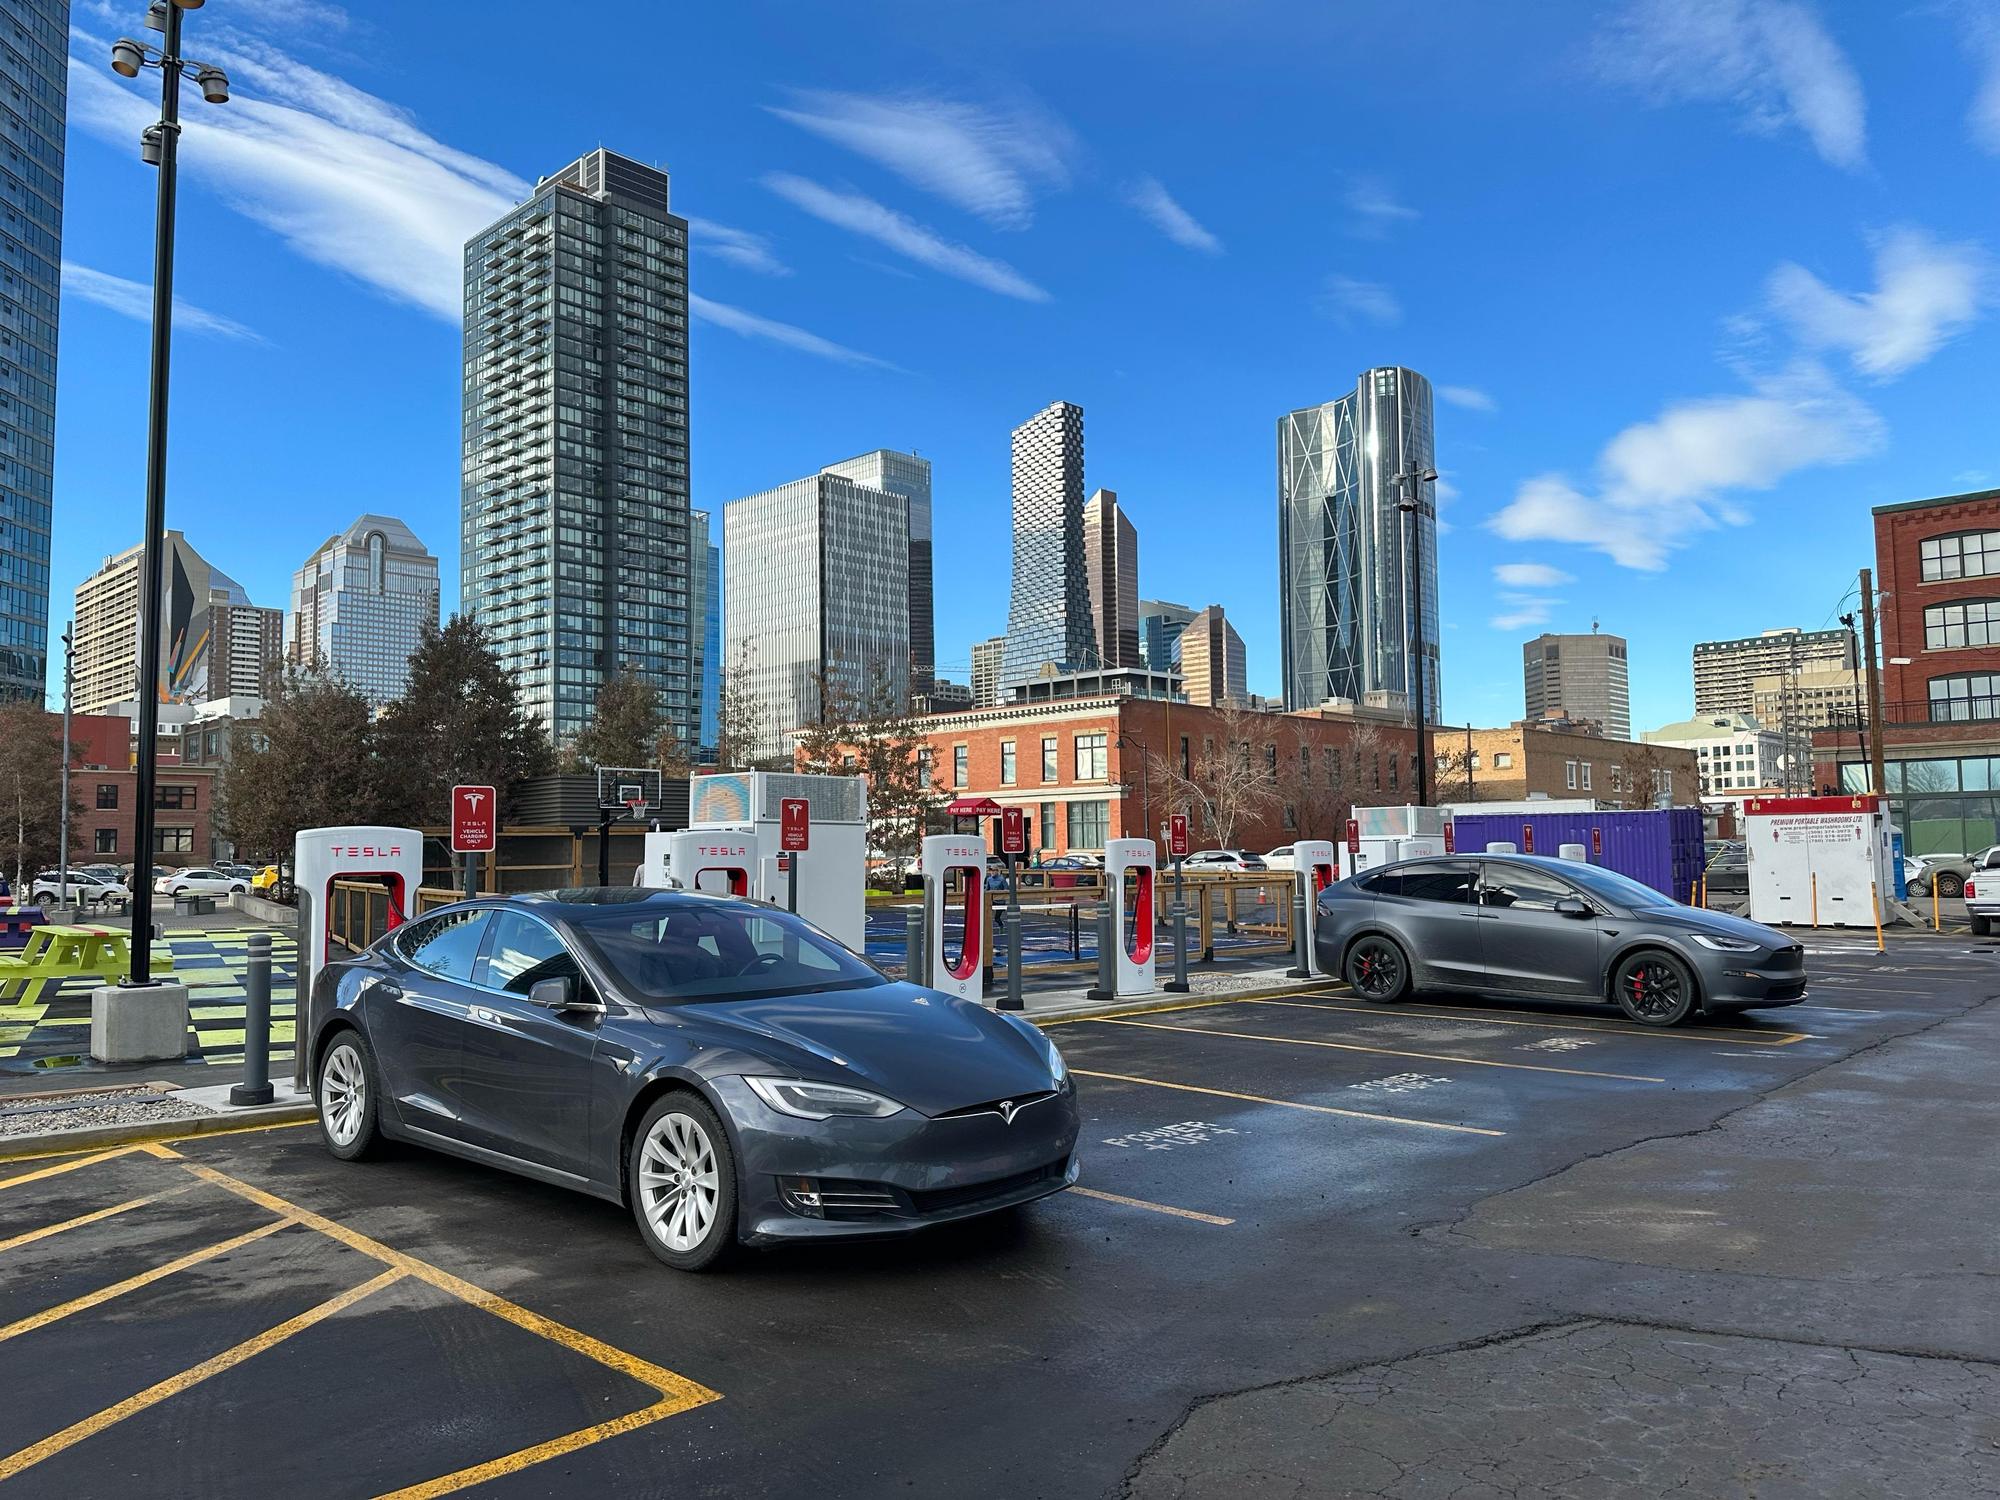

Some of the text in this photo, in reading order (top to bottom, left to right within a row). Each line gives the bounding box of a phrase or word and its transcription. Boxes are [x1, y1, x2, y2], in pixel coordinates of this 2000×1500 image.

[1794, 817, 1819, 825] PORTABLE
[1820, 816, 1852, 824] WASHROOMS
[331, 847, 401, 857] TESLA
[698, 847, 746, 856] TESLA
[945, 848, 980, 856] TESLA
